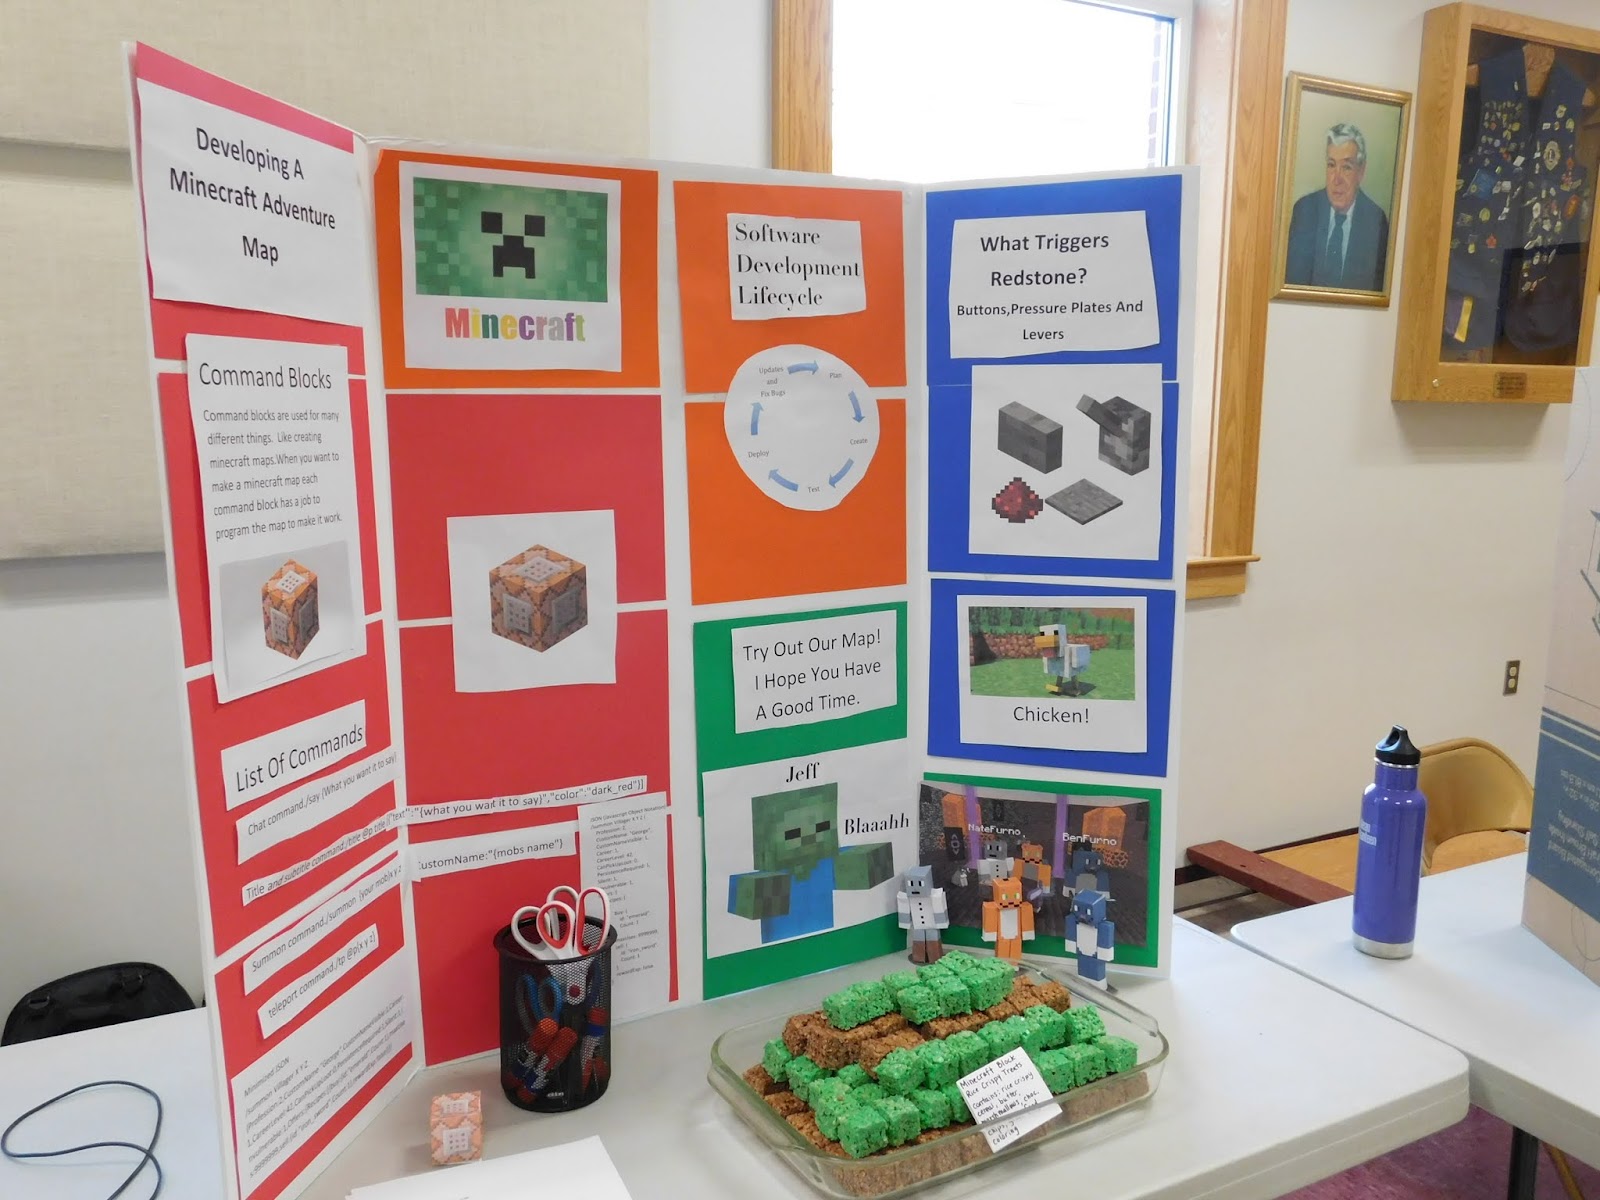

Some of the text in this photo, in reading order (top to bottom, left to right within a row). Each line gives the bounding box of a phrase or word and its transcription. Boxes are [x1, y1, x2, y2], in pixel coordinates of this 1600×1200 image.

[196, 127, 304, 180] Developing A
[170, 168, 335, 229] Minecraft Adventure
[735, 222, 820, 245] Software
[980, 234, 1110, 253] What Triggers
[242, 235, 279, 266] Map
[737, 254, 860, 281] Development
[991, 267, 1087, 287] Redstone?
[739, 285, 823, 311] Lifecycle
[1071, 301, 1112, 314] Plates
[1116, 300, 1143, 313] And
[445, 307, 586, 342] Minecraft
[1023, 328, 1065, 340] Levers
[200, 363, 332, 389] Command Blocks
[759, 366, 784, 375] Updates
[760, 389, 786, 398] Fix Bugs
[203, 409, 339, 423] Command blocks are used for many
[207, 431, 322, 446] different things. Like creating
[210, 455, 250, 469] minecraft
[300, 454, 312, 466] you
[314, 452, 330, 462] want
[332, 452, 339, 461] to
[748, 450, 770, 459] Deploy
[212, 473, 318, 492] make a minecraft map each
[213, 500, 254, 516] command
[257, 497, 279, 511] block
[280, 496, 293, 508] has
[300, 495, 311, 507] job
[313, 495, 320, 504] to
[216, 512, 342, 542] program the map to make it work.
[743, 628, 881, 663] Try Out Our Map!
[755, 661, 881, 690] I Hope You Have
[756, 694, 860, 721] A Good Time.
[1013, 706, 1090, 724] Chicken!
[236, 723, 363, 792] List Of Commands
[785, 762, 820, 784] Jeff
[248, 818, 266, 836] Chat
[343, 774, 355, 789] you
[356, 766, 371, 780] want
[372, 762, 377, 772] it
[377, 759, 384, 769] to
[844, 813, 910, 835] Blaaahh
[968, 823, 1021, 837] NateFurno
[246, 883, 265, 899] Title
[267, 876, 283, 891] and
[284, 861, 311, 882] subtitle
[362, 826, 373, 840] @p
[374, 820, 385, 832] title
[453, 803, 472, 816] you
[499, 798, 505, 807] it
[509, 798, 519, 806] to
[1062, 832, 1117, 846] BenFurno
[252, 943, 287, 972] Summon
[268, 987, 298, 1018] teleport
[364, 938, 369, 948] y
[960, 1055, 1016, 1090] Minecraft Block
[966, 1062, 1023, 1098] Rice Crispy Treats
[1001, 1084, 1013, 1093] rice
[1014, 1072, 1034, 1086] crispy
